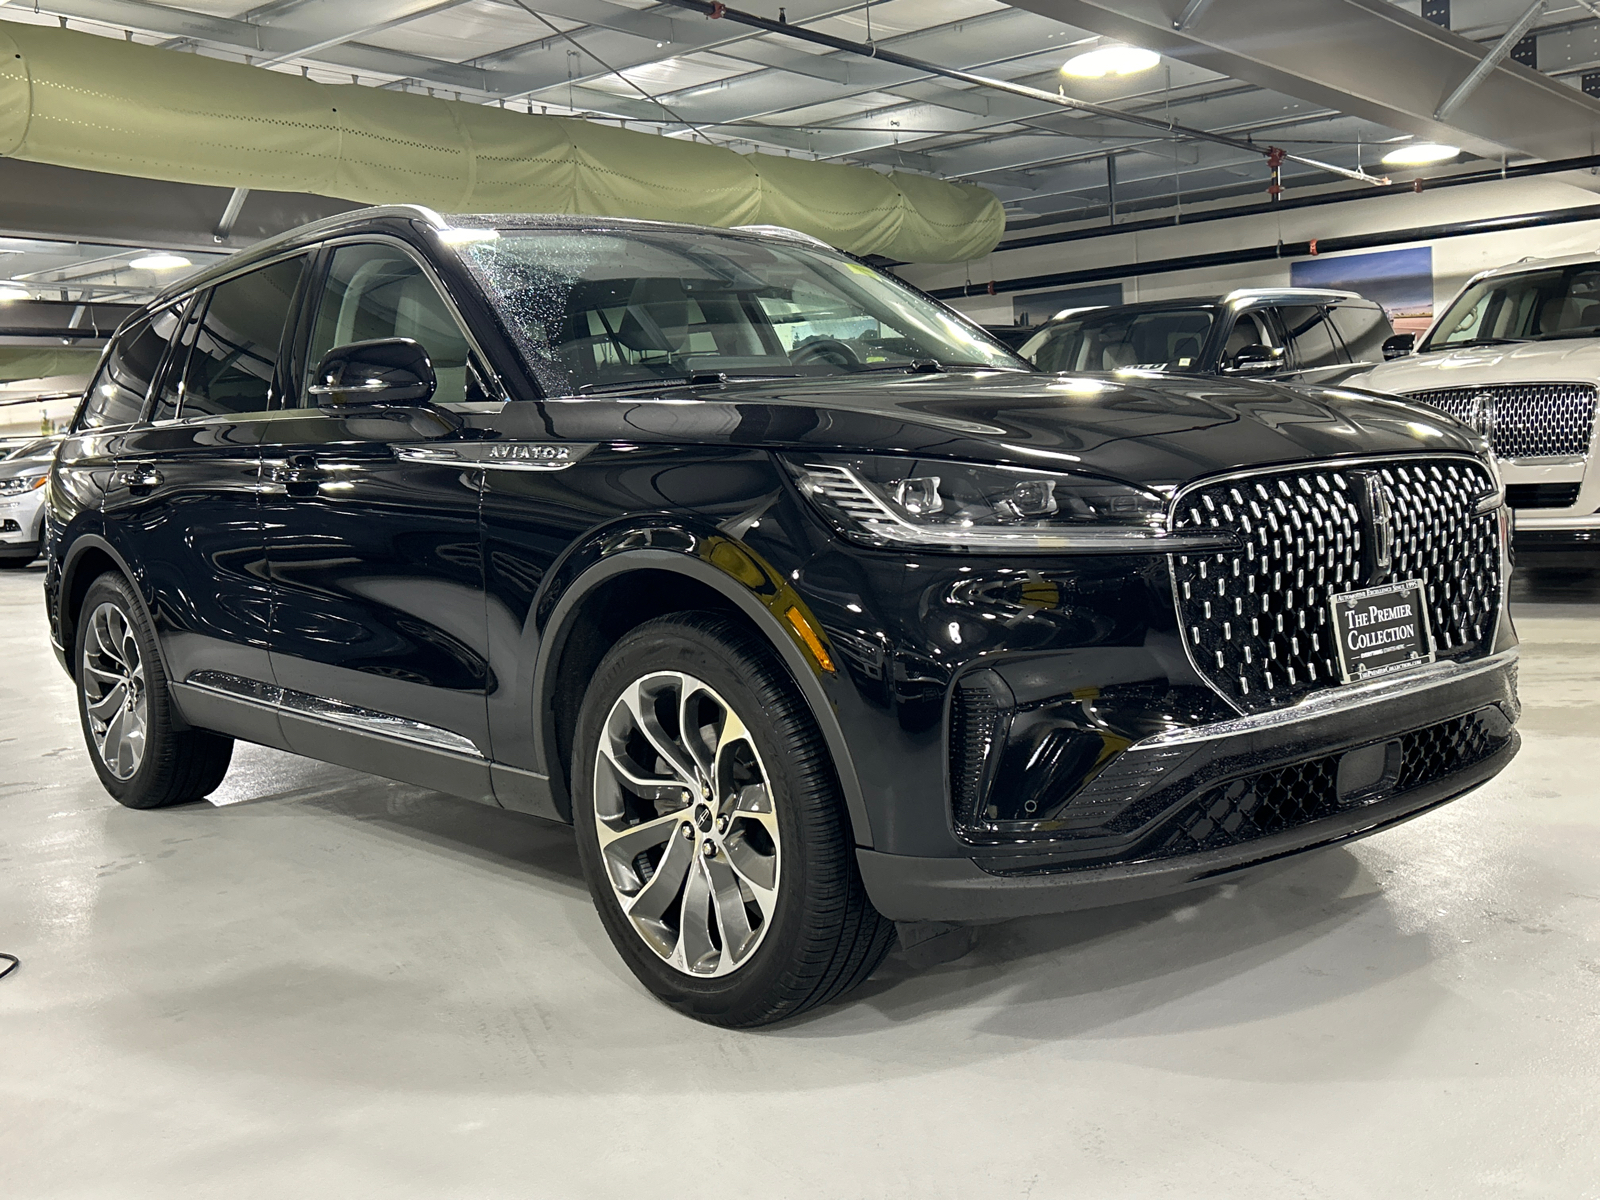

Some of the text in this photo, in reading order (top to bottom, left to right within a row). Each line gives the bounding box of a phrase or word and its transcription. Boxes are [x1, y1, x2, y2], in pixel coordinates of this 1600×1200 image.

[489, 445, 570, 459] AVIATOR
[1345, 604, 1413, 630] THE PREMIER
[1347, 624, 1415, 651] COLLECTION
